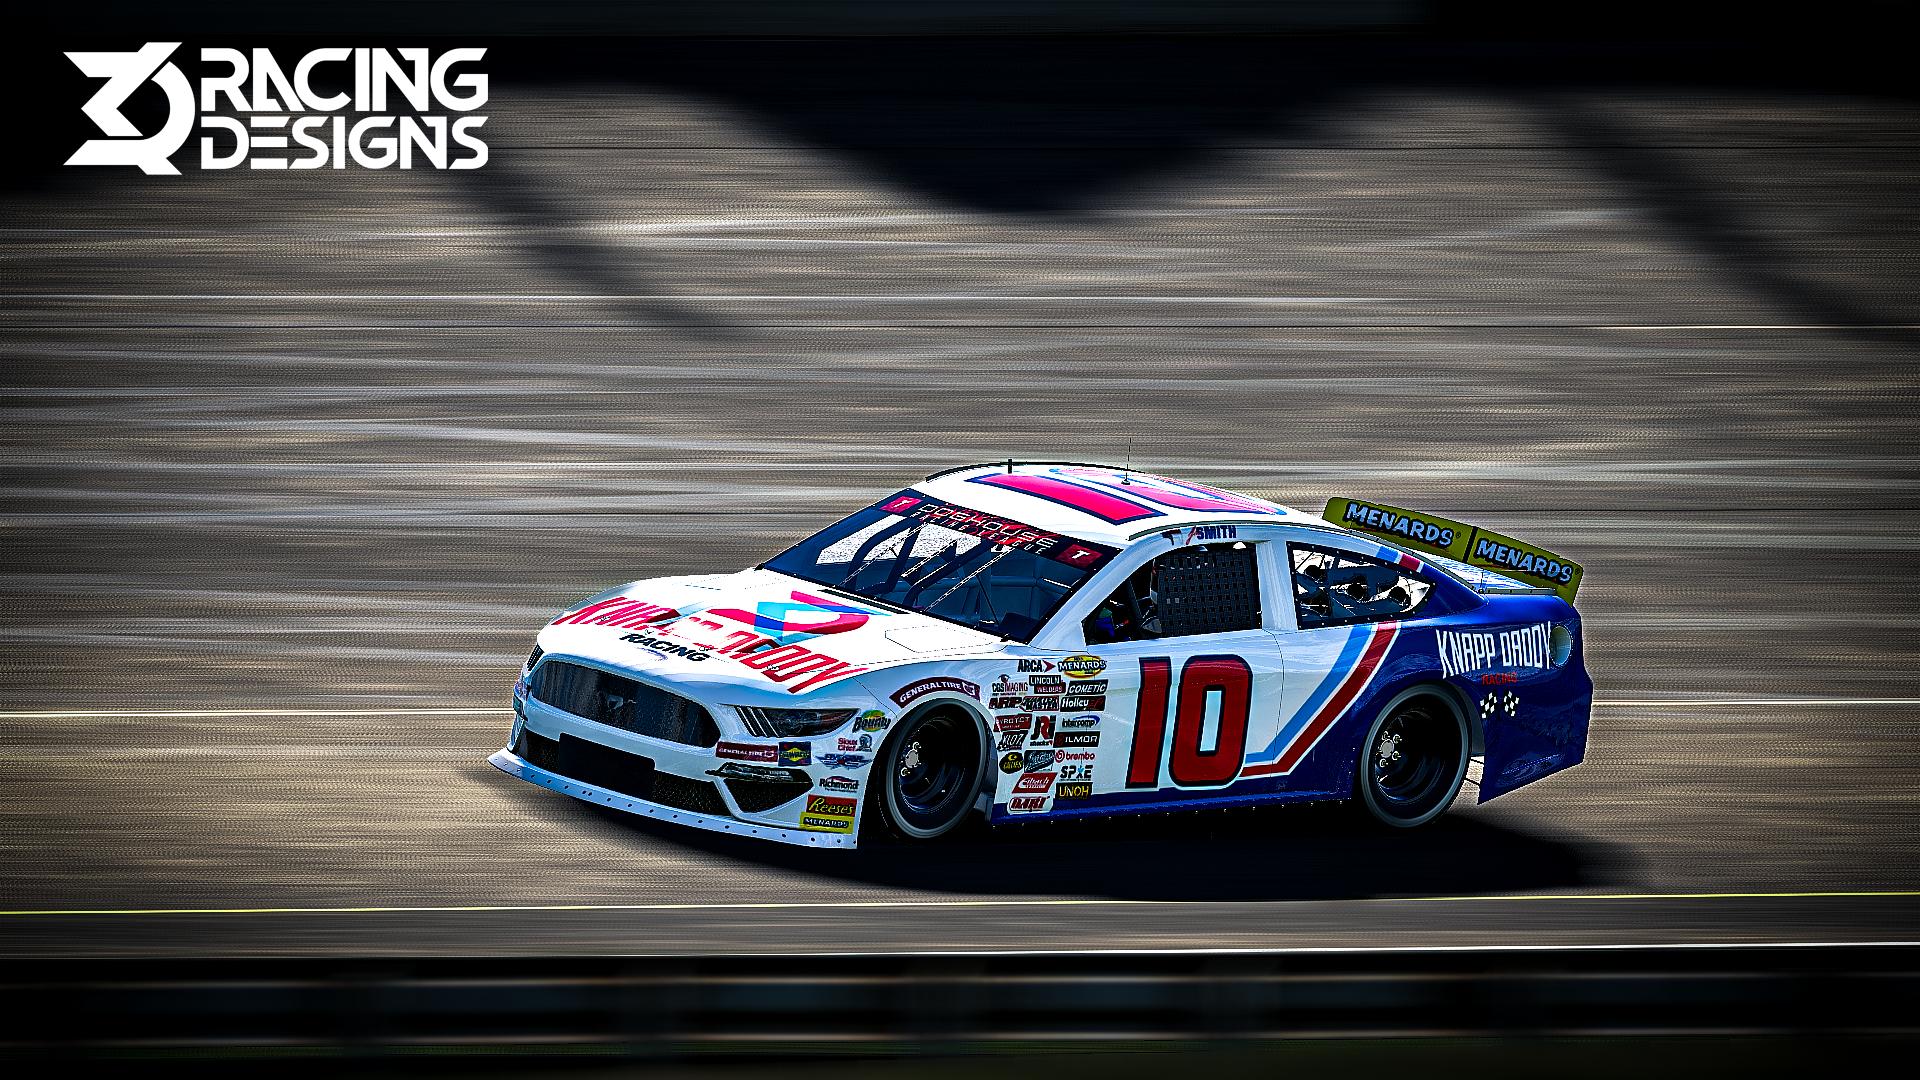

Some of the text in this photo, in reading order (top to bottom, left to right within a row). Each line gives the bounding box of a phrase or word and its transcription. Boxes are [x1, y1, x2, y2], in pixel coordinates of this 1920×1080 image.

[1345, 502, 1456, 547] MENARDS
[1195, 525, 1237, 540] SMITH
[1475, 538, 1575, 583] MENARDS
[619, 633, 711, 661] RACING
[1436, 621, 1552, 679] KNAPP DADDY
[1017, 659, 1043, 673] ARCA
[1057, 659, 1107, 672] MENARDS
[1029, 675, 1060, 685] LINCOLN
[1481, 672, 1518, 685] RACING
[900, 681, 962, 703] GENERAL TIRE
[1069, 682, 1107, 694] COMETIC
[1125, 653, 1254, 791] 10
[1064, 735, 1098, 744] ILMOR
[719, 747, 748, 756] GENERAL
[1066, 751, 1096, 761] brembo
[819, 777, 860, 790] Richmond
[1059, 785, 1090, 798] UNOH
[808, 797, 855, 815] Reese's
[804, 818, 850, 828] MENARDS
